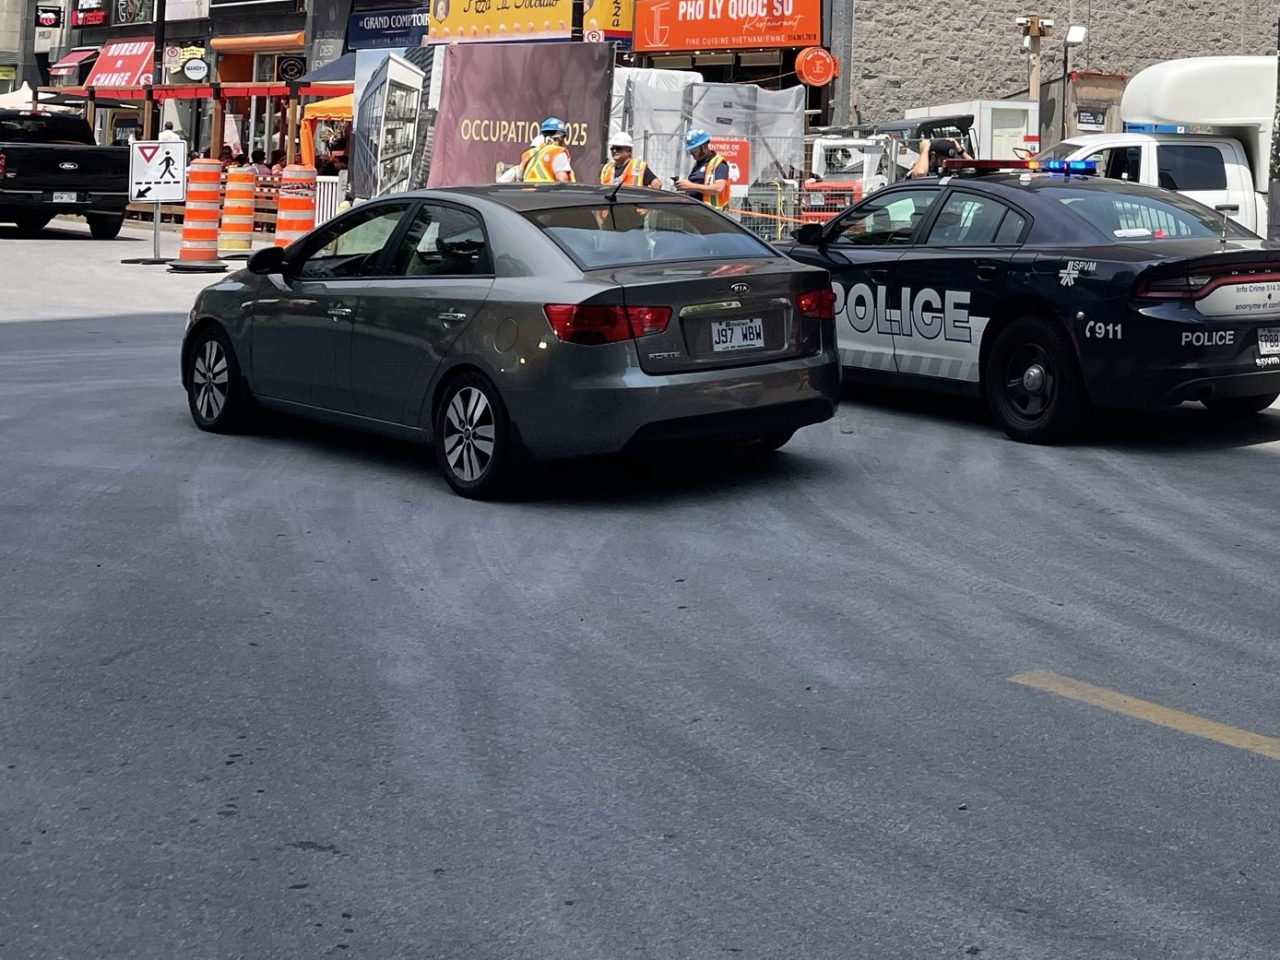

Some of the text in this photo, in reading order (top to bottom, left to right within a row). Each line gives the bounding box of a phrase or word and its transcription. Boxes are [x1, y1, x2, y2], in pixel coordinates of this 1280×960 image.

[364, 17, 389, 29] GRAND
[391, 13, 430, 28] COMPTOIR
[742, 15, 804, 34] Restaurant
[685, 38, 699, 46] FINE
[702, 37, 729, 45] CUISINE
[732, 35, 785, 44] VIETNAMIENNE
[107, 42, 146, 57] BUREAU
[92, 73, 132, 87] CHANGE
[461, 119, 588, 146] OCCUPATIO 025
[1072, 260, 1097, 271] SPVM
[1235, 301, 1261, 311] anonyme
[1262, 301, 1268, 309] et
[714, 324, 762, 344] J97 WBW
[1094, 322, 1122, 340] 911
[1181, 330, 1234, 346] POLICE
